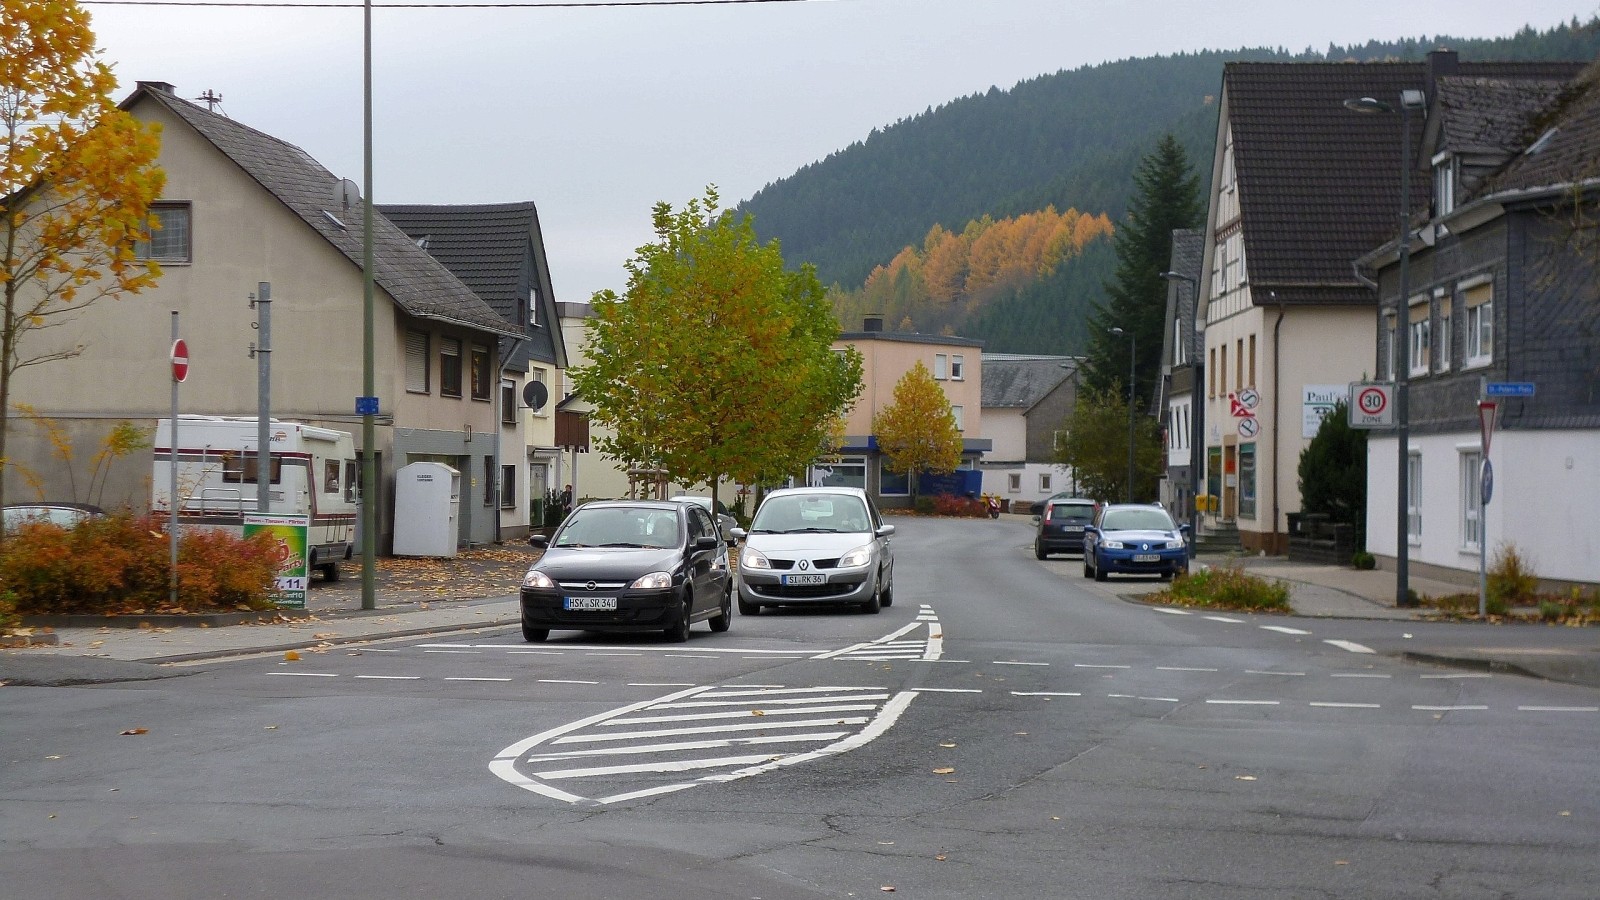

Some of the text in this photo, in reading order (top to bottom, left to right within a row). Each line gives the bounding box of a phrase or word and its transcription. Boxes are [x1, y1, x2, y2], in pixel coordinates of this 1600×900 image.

[1364, 395, 1381, 408] 30
[789, 575, 822, 584] SI RK 36
[569, 598, 617, 608] HSK SR 340
